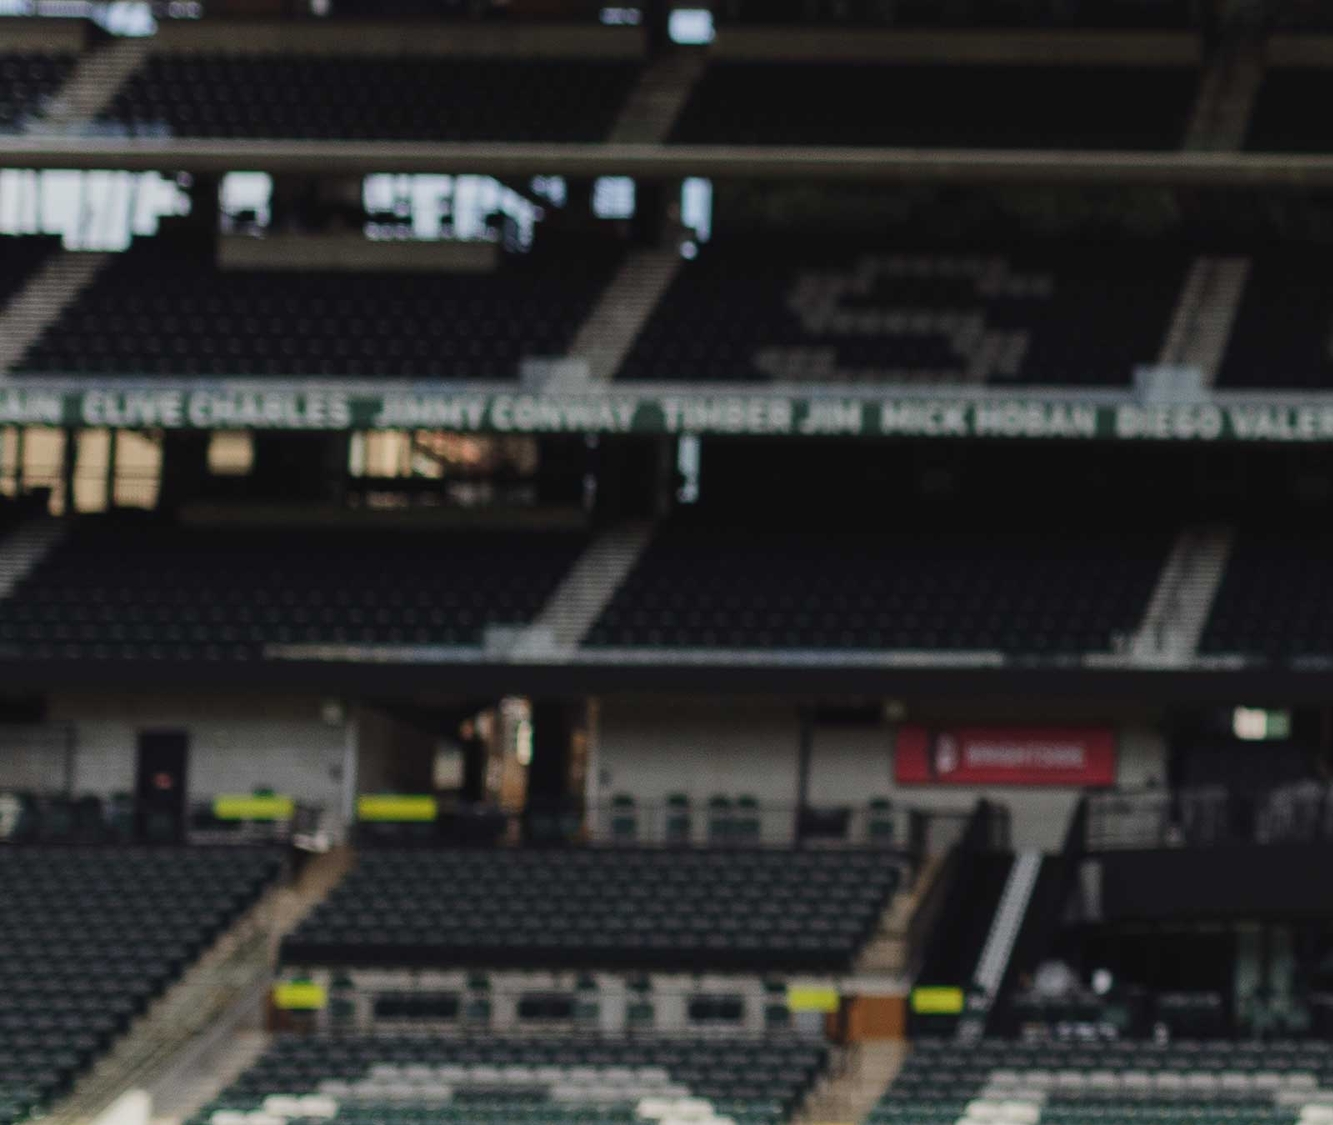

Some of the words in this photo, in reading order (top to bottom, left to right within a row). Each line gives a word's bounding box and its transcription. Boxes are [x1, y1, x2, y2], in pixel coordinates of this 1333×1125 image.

[82, 390, 182, 427] CLIVE
[187, 391, 350, 430] CHARLES
[374, 396, 489, 430] JIMMY
[491, 396, 636, 432] CONWAY
[661, 399, 791, 434] TIMBER
[799, 400, 862, 435] JIM
[881, 401, 968, 437] MICK
[976, 402, 1096, 438] HOBAN
[1115, 404, 1222, 440] DIEGO
